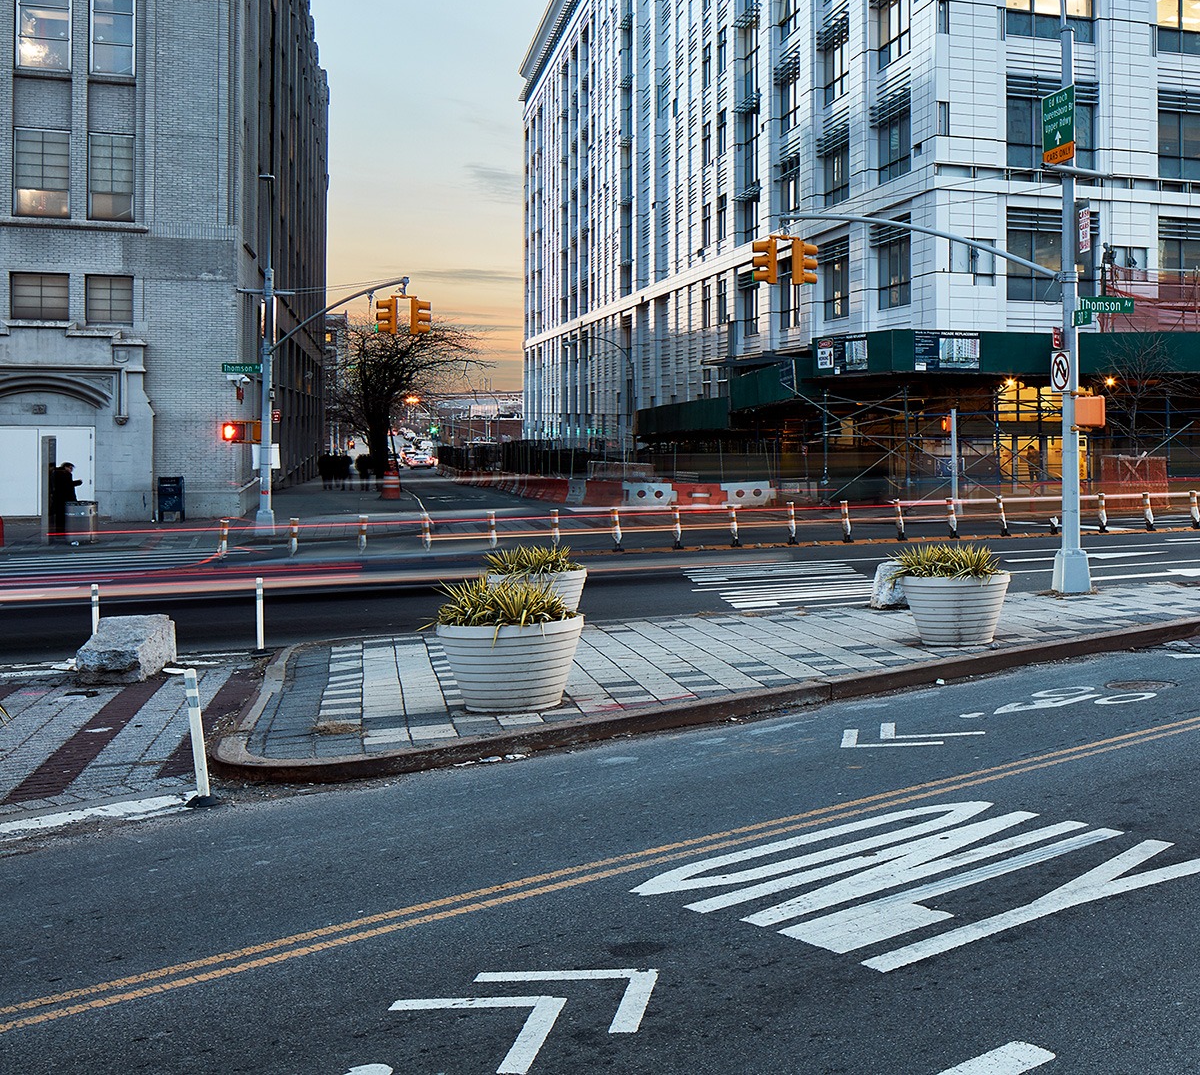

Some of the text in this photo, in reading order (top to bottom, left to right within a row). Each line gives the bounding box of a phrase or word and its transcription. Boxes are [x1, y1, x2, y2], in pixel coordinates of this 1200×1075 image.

[1048, 92, 1068, 108] Ed Koch
[1043, 105, 1068, 122] Queensboro
[1045, 121, 1059, 135] Upper
[1046, 145, 1072, 163] CARS ONLY
[1081, 298, 1121, 311] Thomson
[223, 364, 253, 372] Thomson
